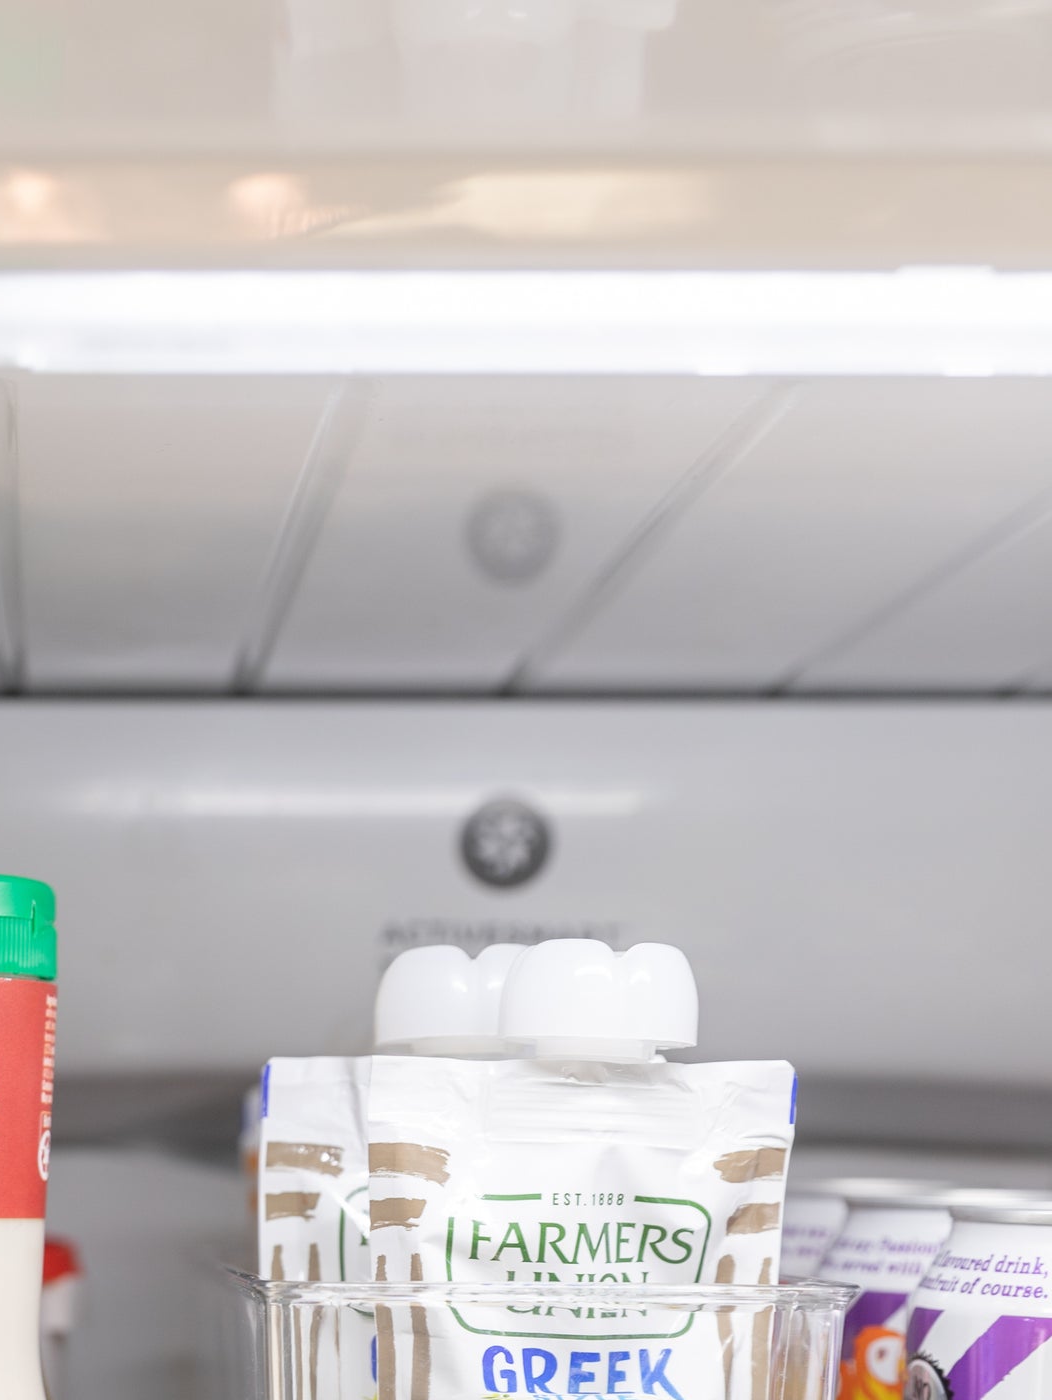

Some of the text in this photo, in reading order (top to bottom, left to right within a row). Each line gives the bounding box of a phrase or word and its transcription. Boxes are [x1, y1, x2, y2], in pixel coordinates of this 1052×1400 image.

[468, 1219, 695, 1265] FARMERS
[994, 1255, 1049, 1278] drink,
[960, 1278, 981, 1295] of
[981, 1283, 1049, 1299] course.
